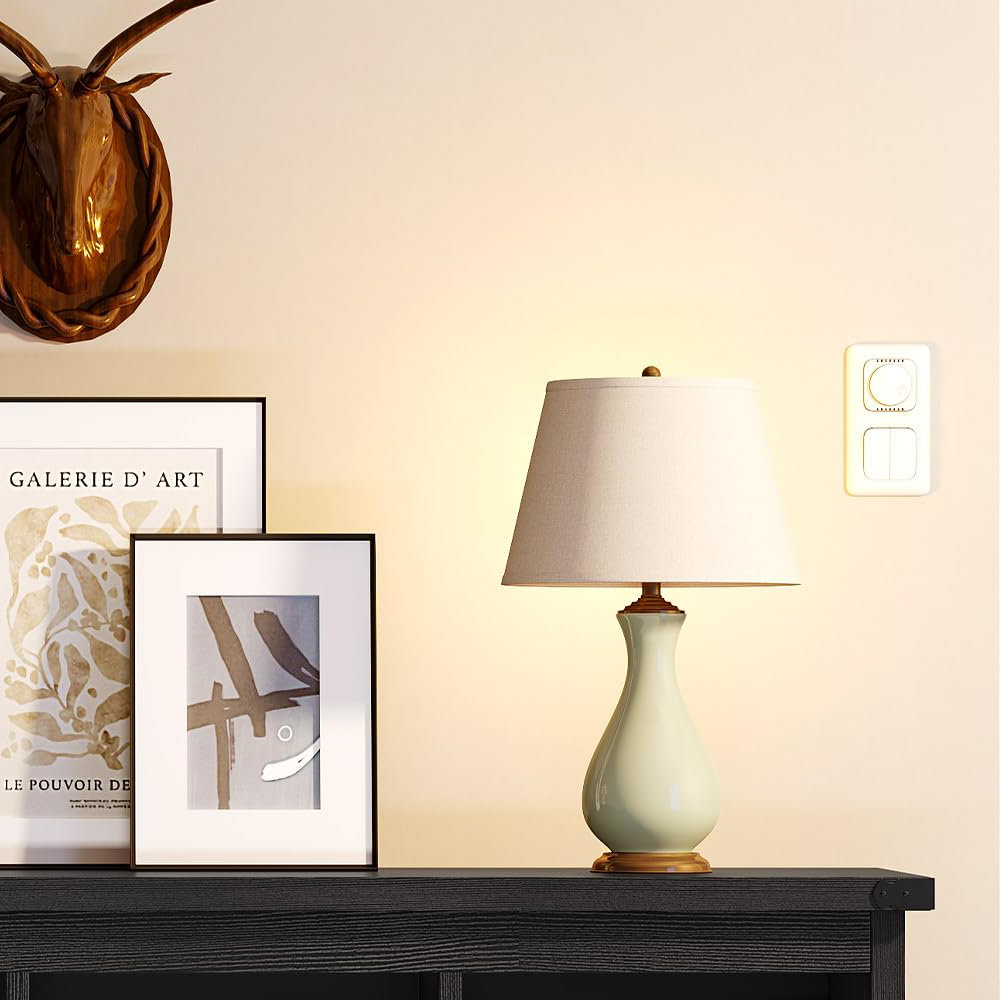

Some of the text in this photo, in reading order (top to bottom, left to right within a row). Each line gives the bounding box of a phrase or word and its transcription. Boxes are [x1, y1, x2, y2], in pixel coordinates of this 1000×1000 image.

[9, 471, 114, 488] GALERIE
[156, 471, 204, 488] ART
[4, 779, 23, 791] LE
[29, 779, 103, 791] POUVOIR
